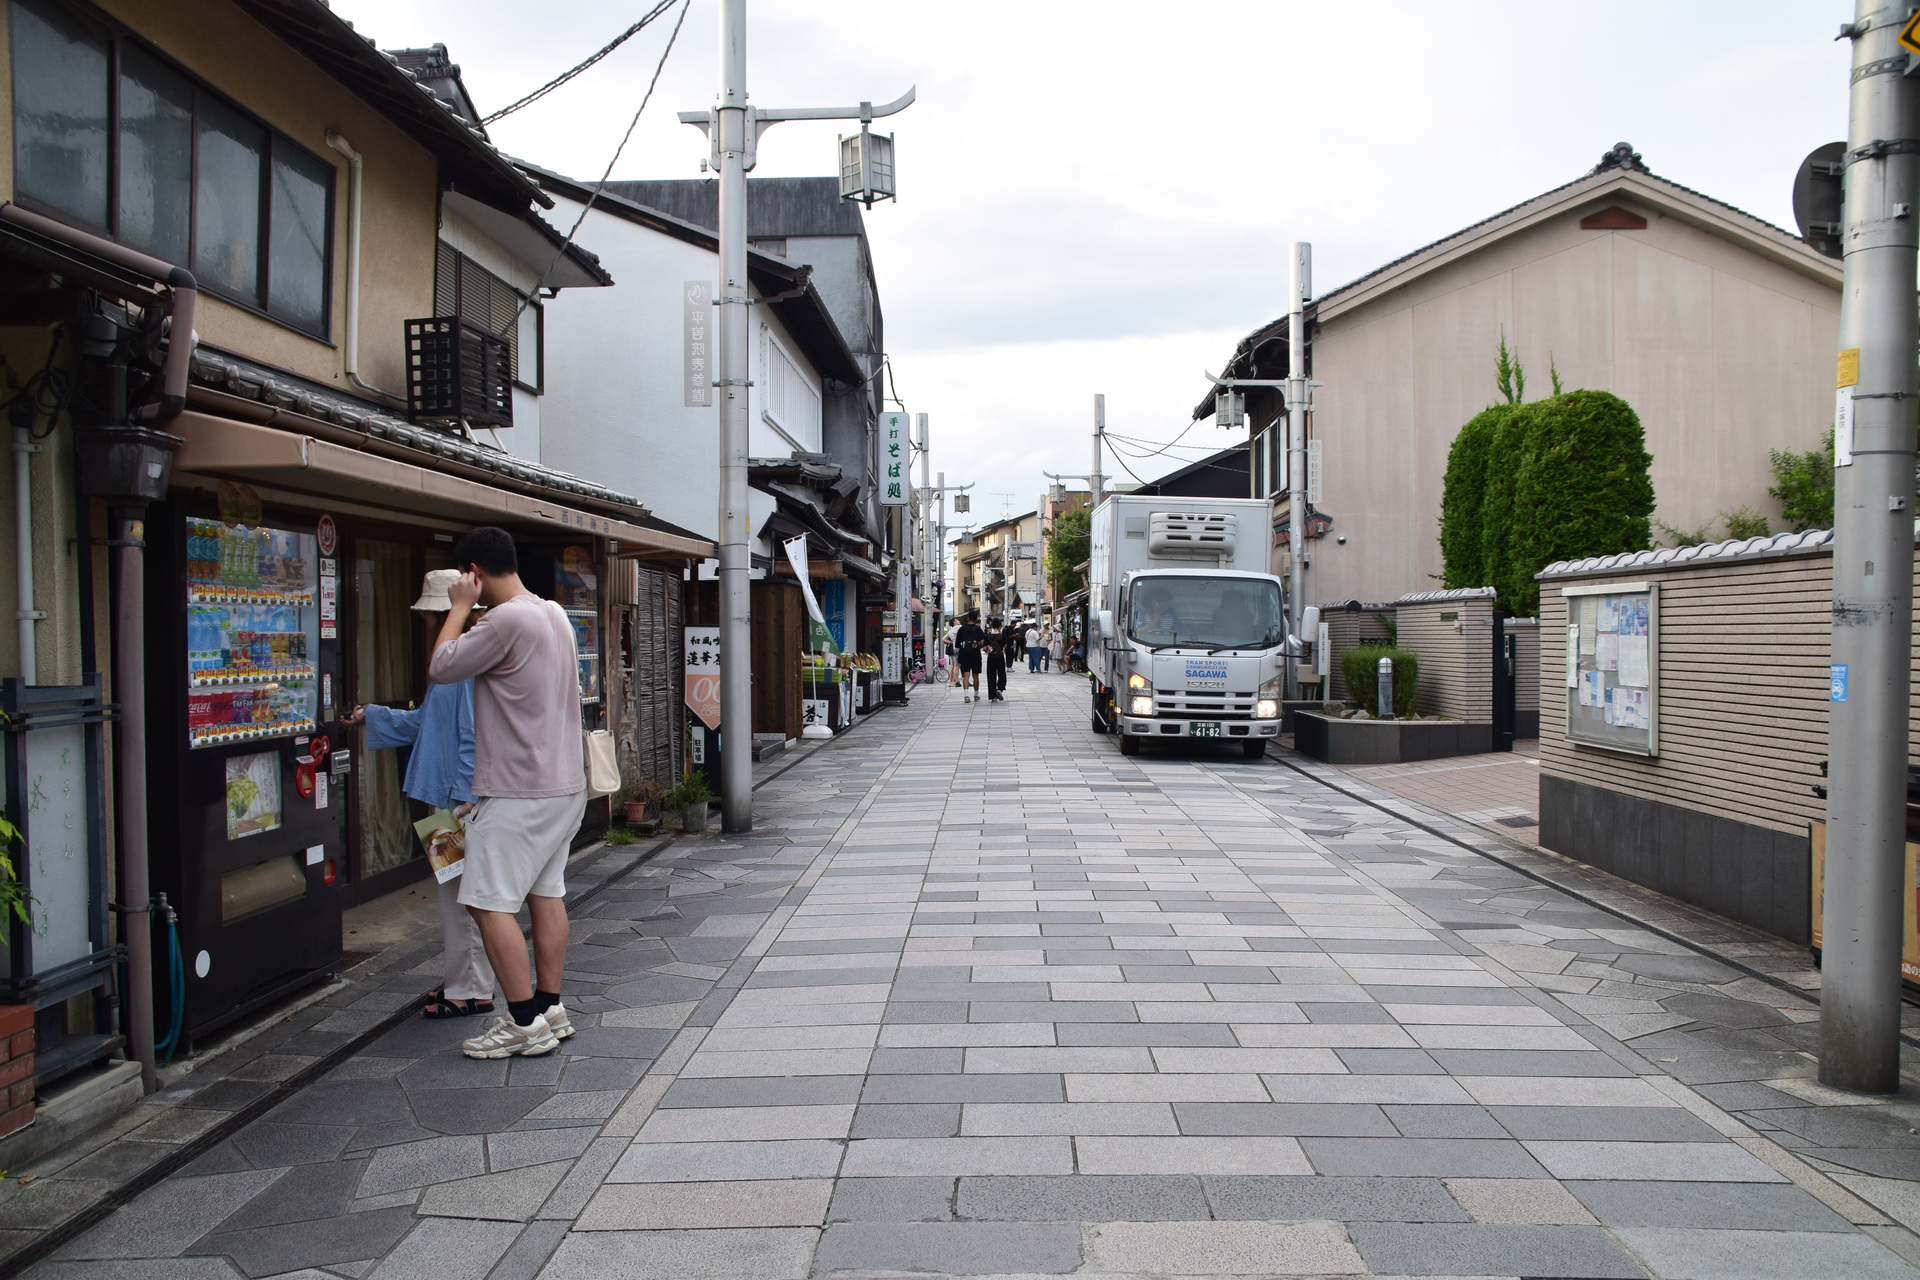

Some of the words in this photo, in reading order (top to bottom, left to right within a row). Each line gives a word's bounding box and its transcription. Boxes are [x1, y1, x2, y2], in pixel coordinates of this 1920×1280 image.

[887, 416, 902, 499] 手打そば処
[561, 510, 609, 534] 西村商店
[1185, 669, 1227, 678] SAGAWA
[1187, 680, 1225, 688] ISUZU
[700, 709, 721, 717] COFFE
[1196, 728, 1220, 737] 61-82
[694, 739, 702, 762] 駐車場
